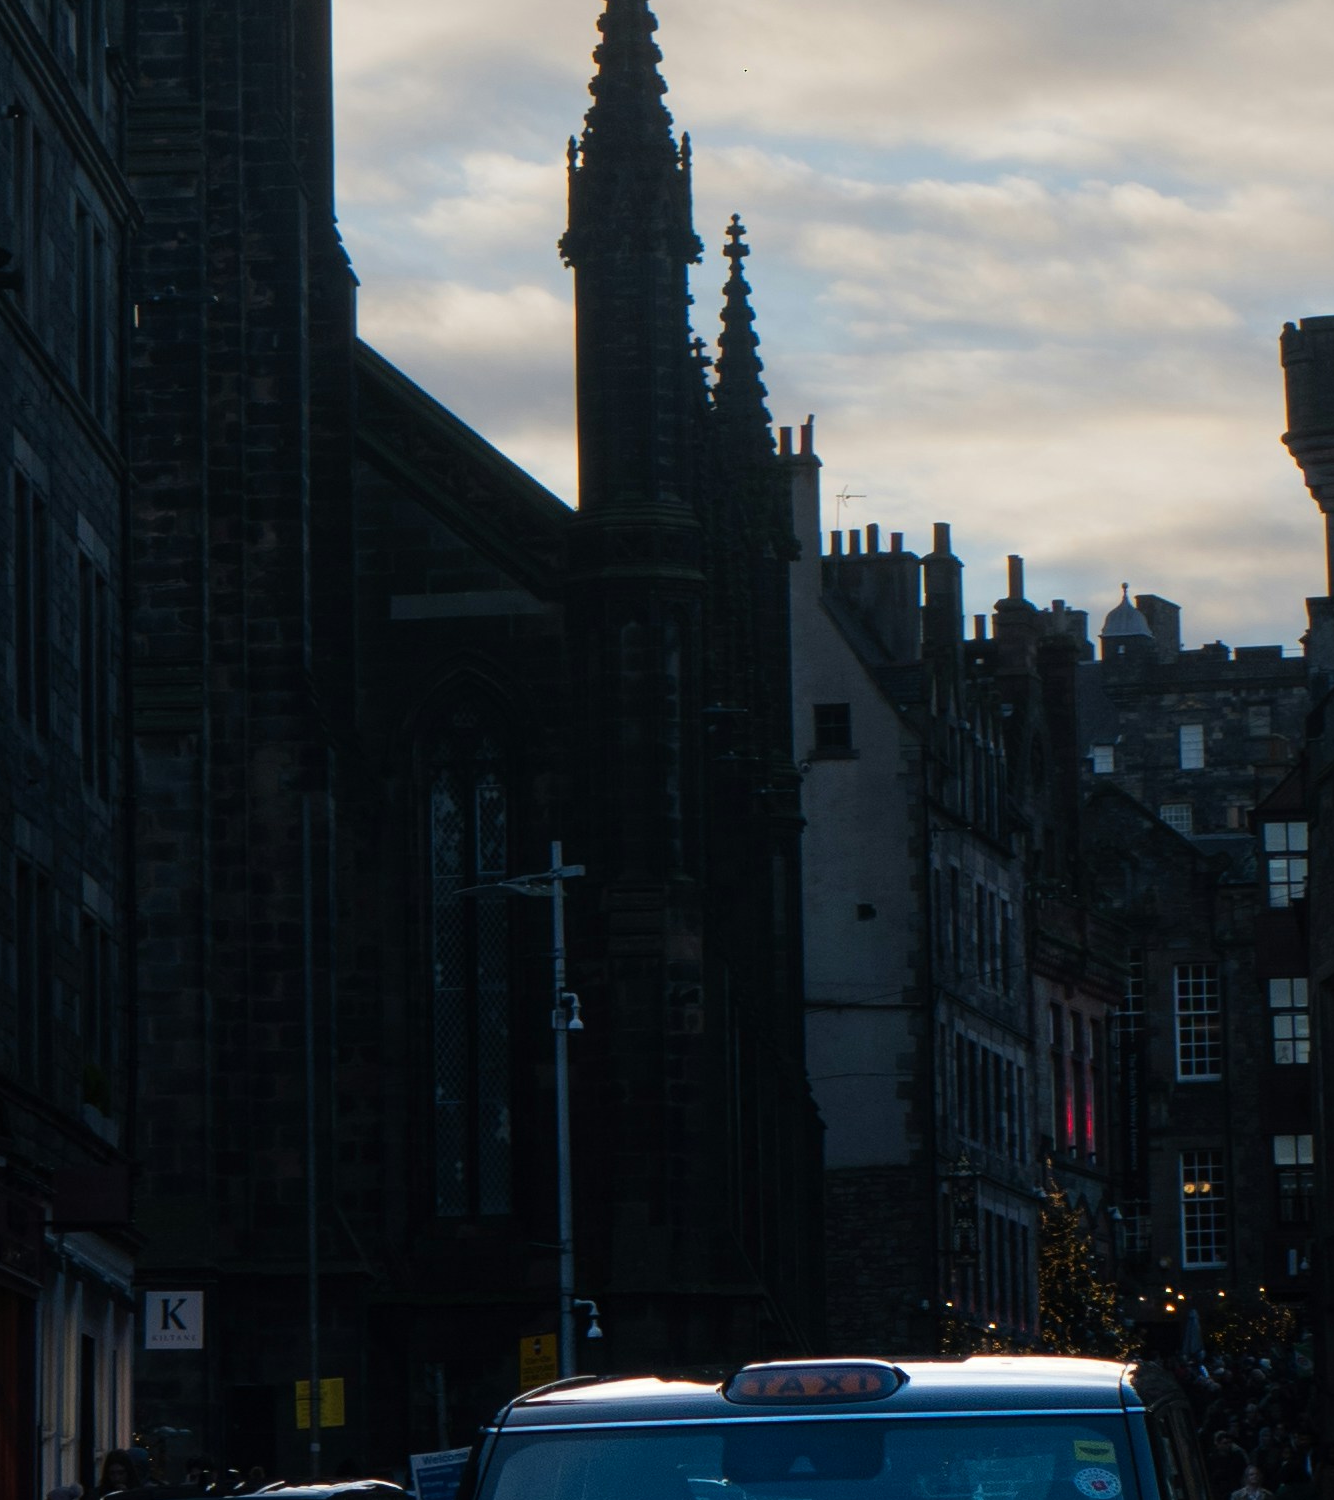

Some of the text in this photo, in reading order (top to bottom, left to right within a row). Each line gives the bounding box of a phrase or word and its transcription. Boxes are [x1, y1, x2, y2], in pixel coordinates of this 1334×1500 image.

[161, 1298, 187, 1330] K
[152, 1334, 197, 1342] KILTANE
[753, 1373, 868, 1395] TAXI
